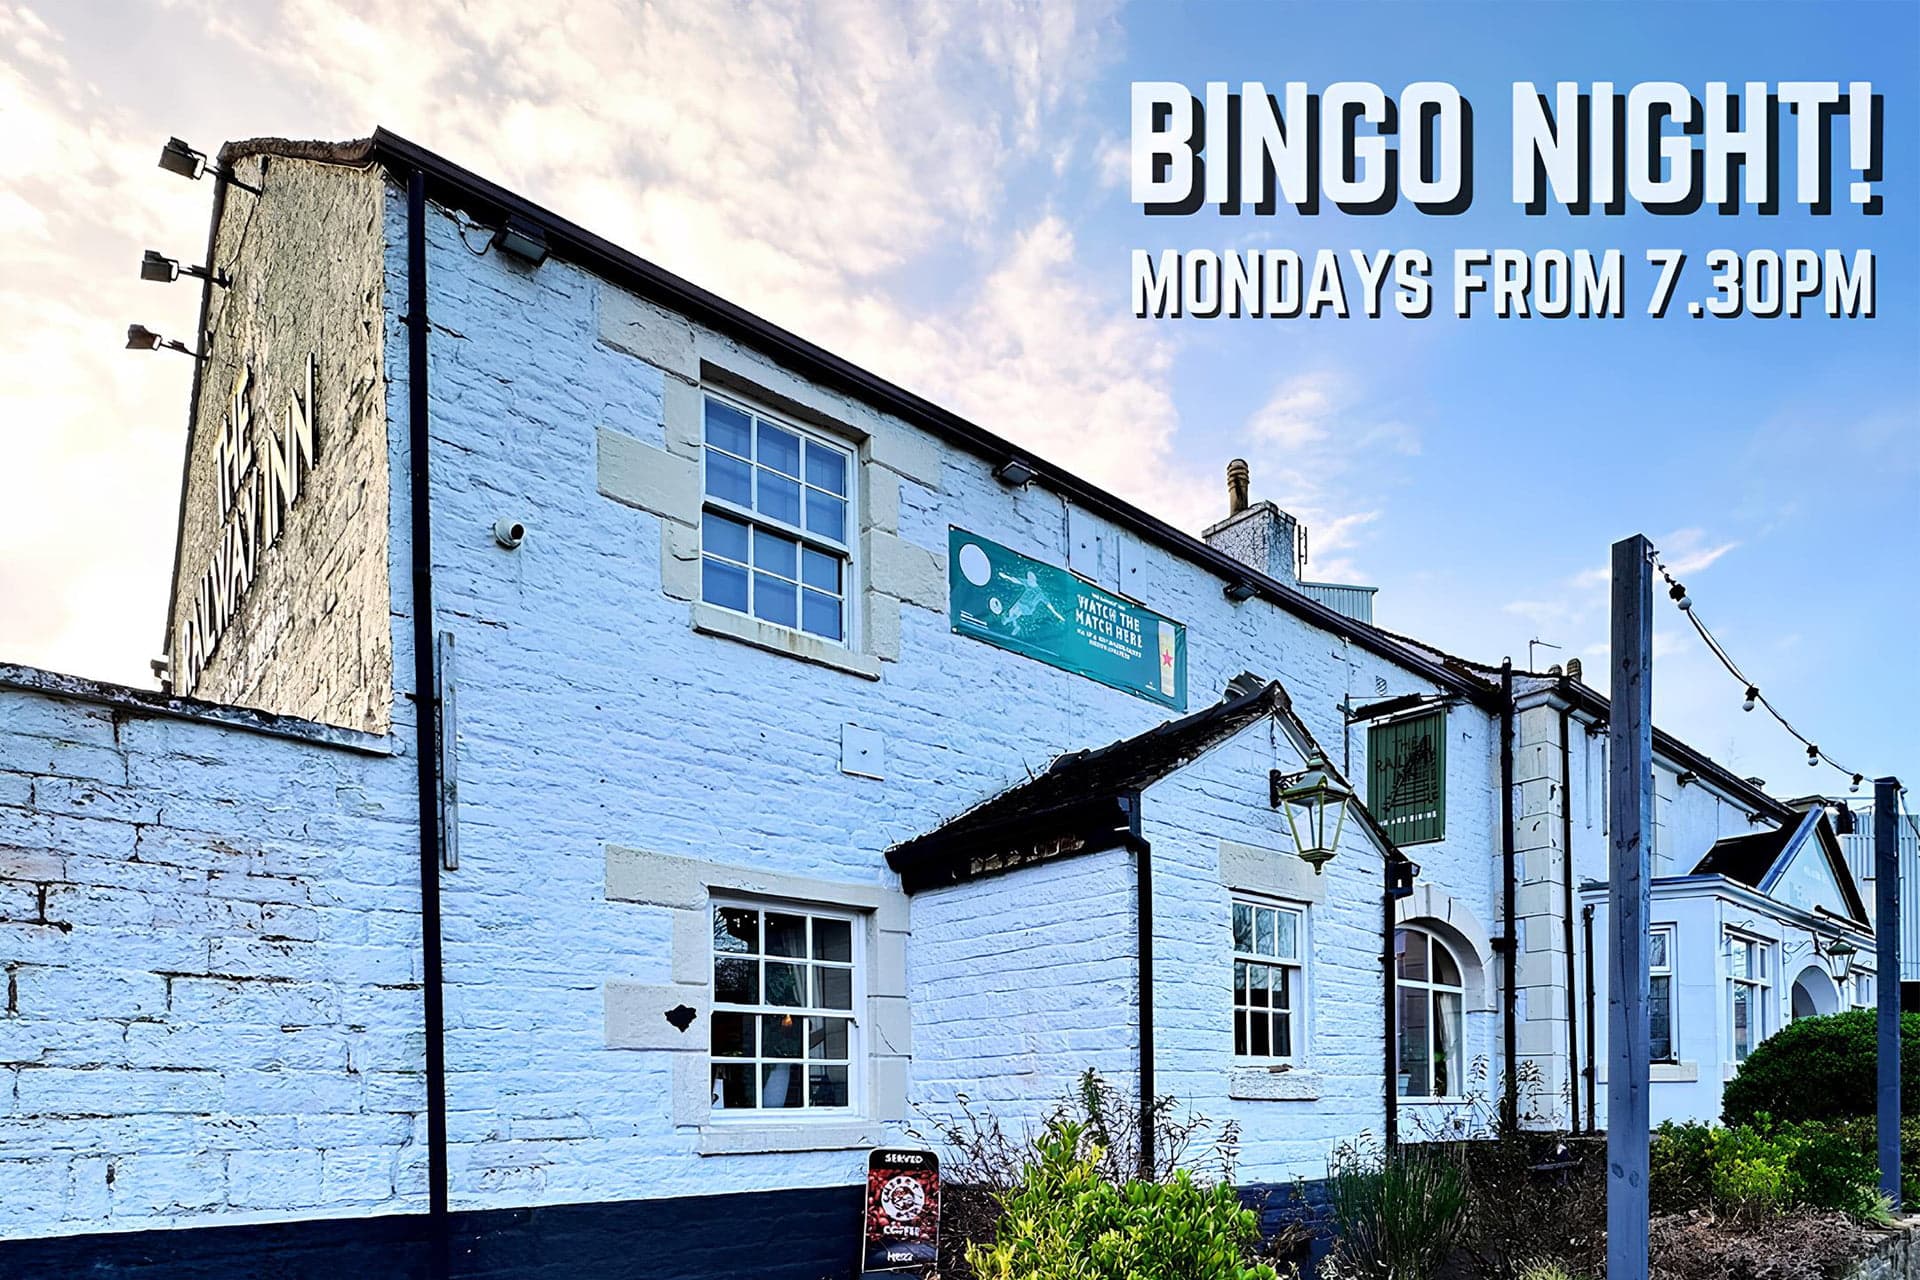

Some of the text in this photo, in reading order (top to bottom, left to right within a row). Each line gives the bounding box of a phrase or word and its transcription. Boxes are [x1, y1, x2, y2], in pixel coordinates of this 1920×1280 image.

[213, 357, 252, 529] THE
[182, 350, 316, 698] RAILWAY INN
[1075, 608, 1113, 637] MATCH
[1115, 625, 1143, 649] HERE
[1076, 593, 1117, 624] WATCH
[1119, 612, 1140, 633] THE
[884, 1153, 924, 1165] SERVED
[883, 1225, 920, 1237] COFFEE
